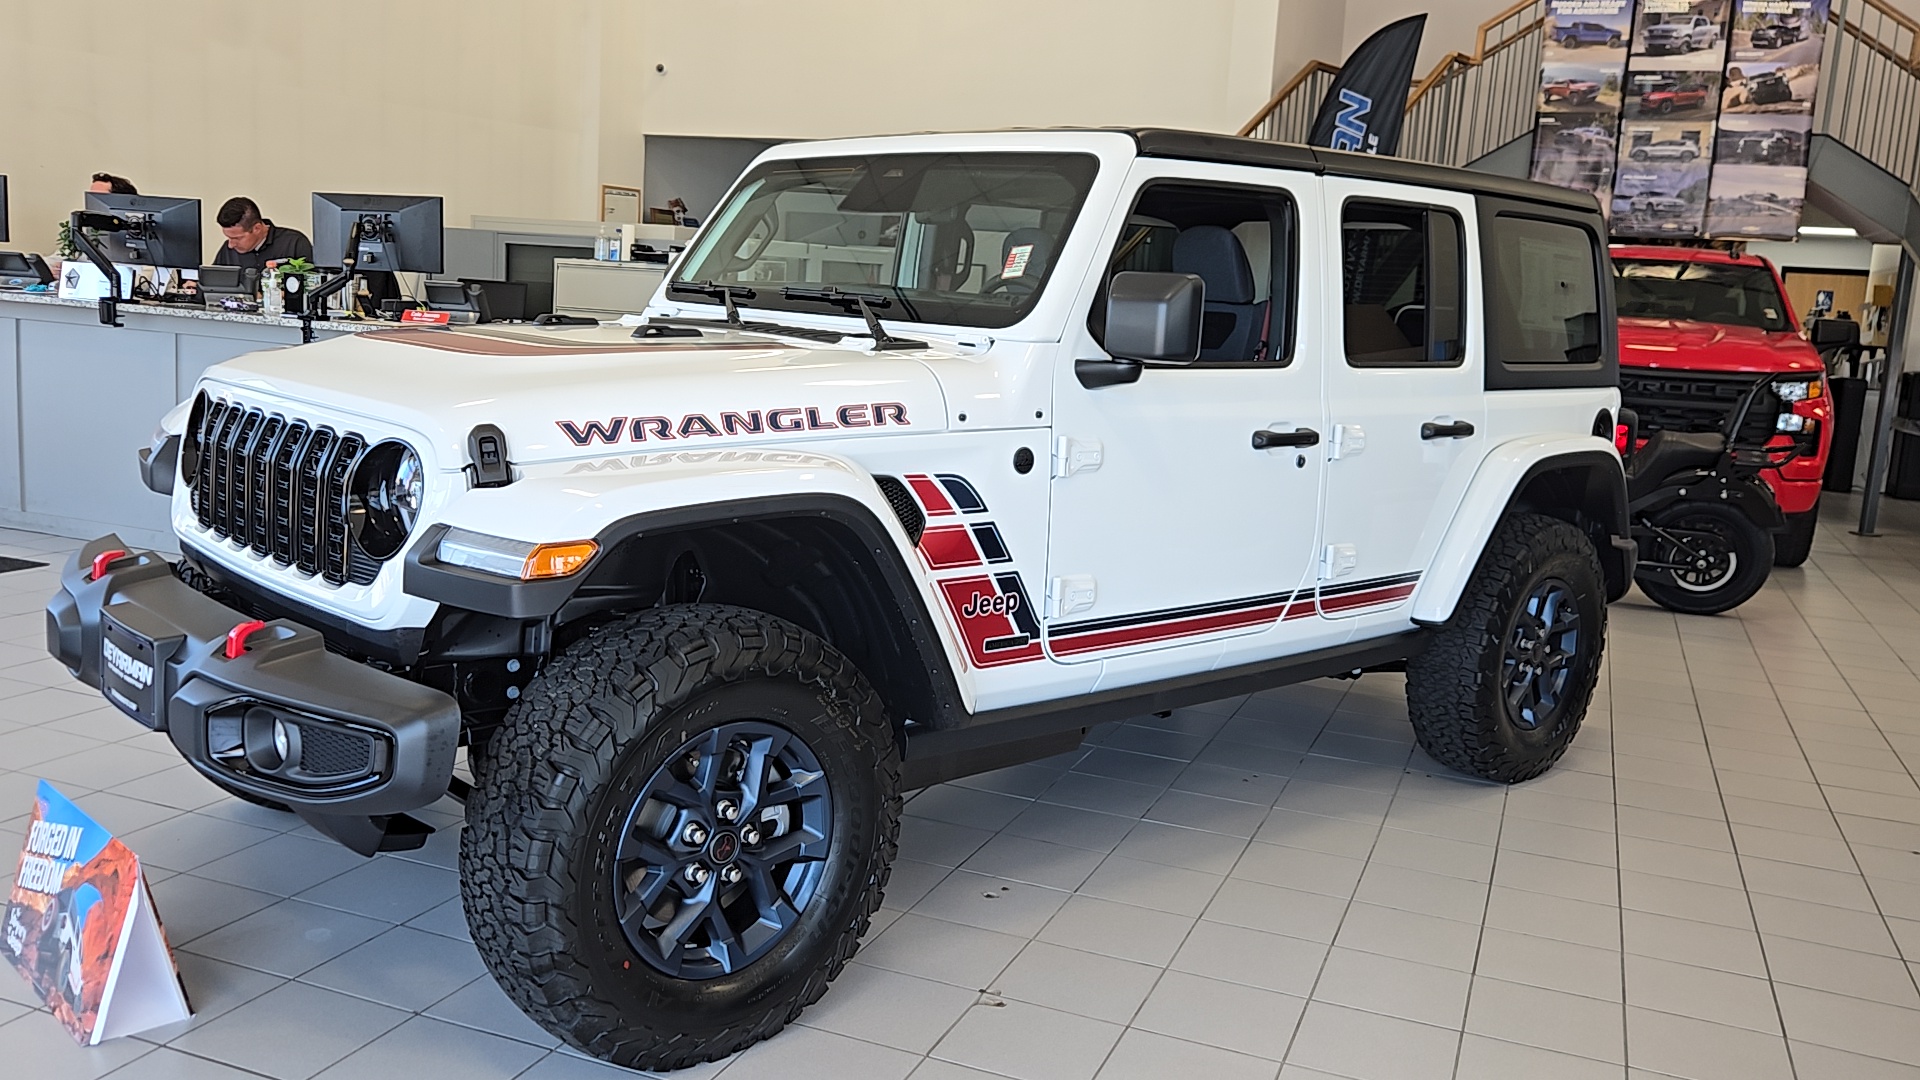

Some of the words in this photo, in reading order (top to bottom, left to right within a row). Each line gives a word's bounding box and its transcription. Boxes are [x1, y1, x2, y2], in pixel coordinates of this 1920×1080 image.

[555, 402, 911, 446] WRANGLER
[962, 592, 1019, 618] Jeep
[26, 820, 69, 858] FORGED
[63, 826, 84, 861] IN
[17, 855, 67, 895] FREEDOM
